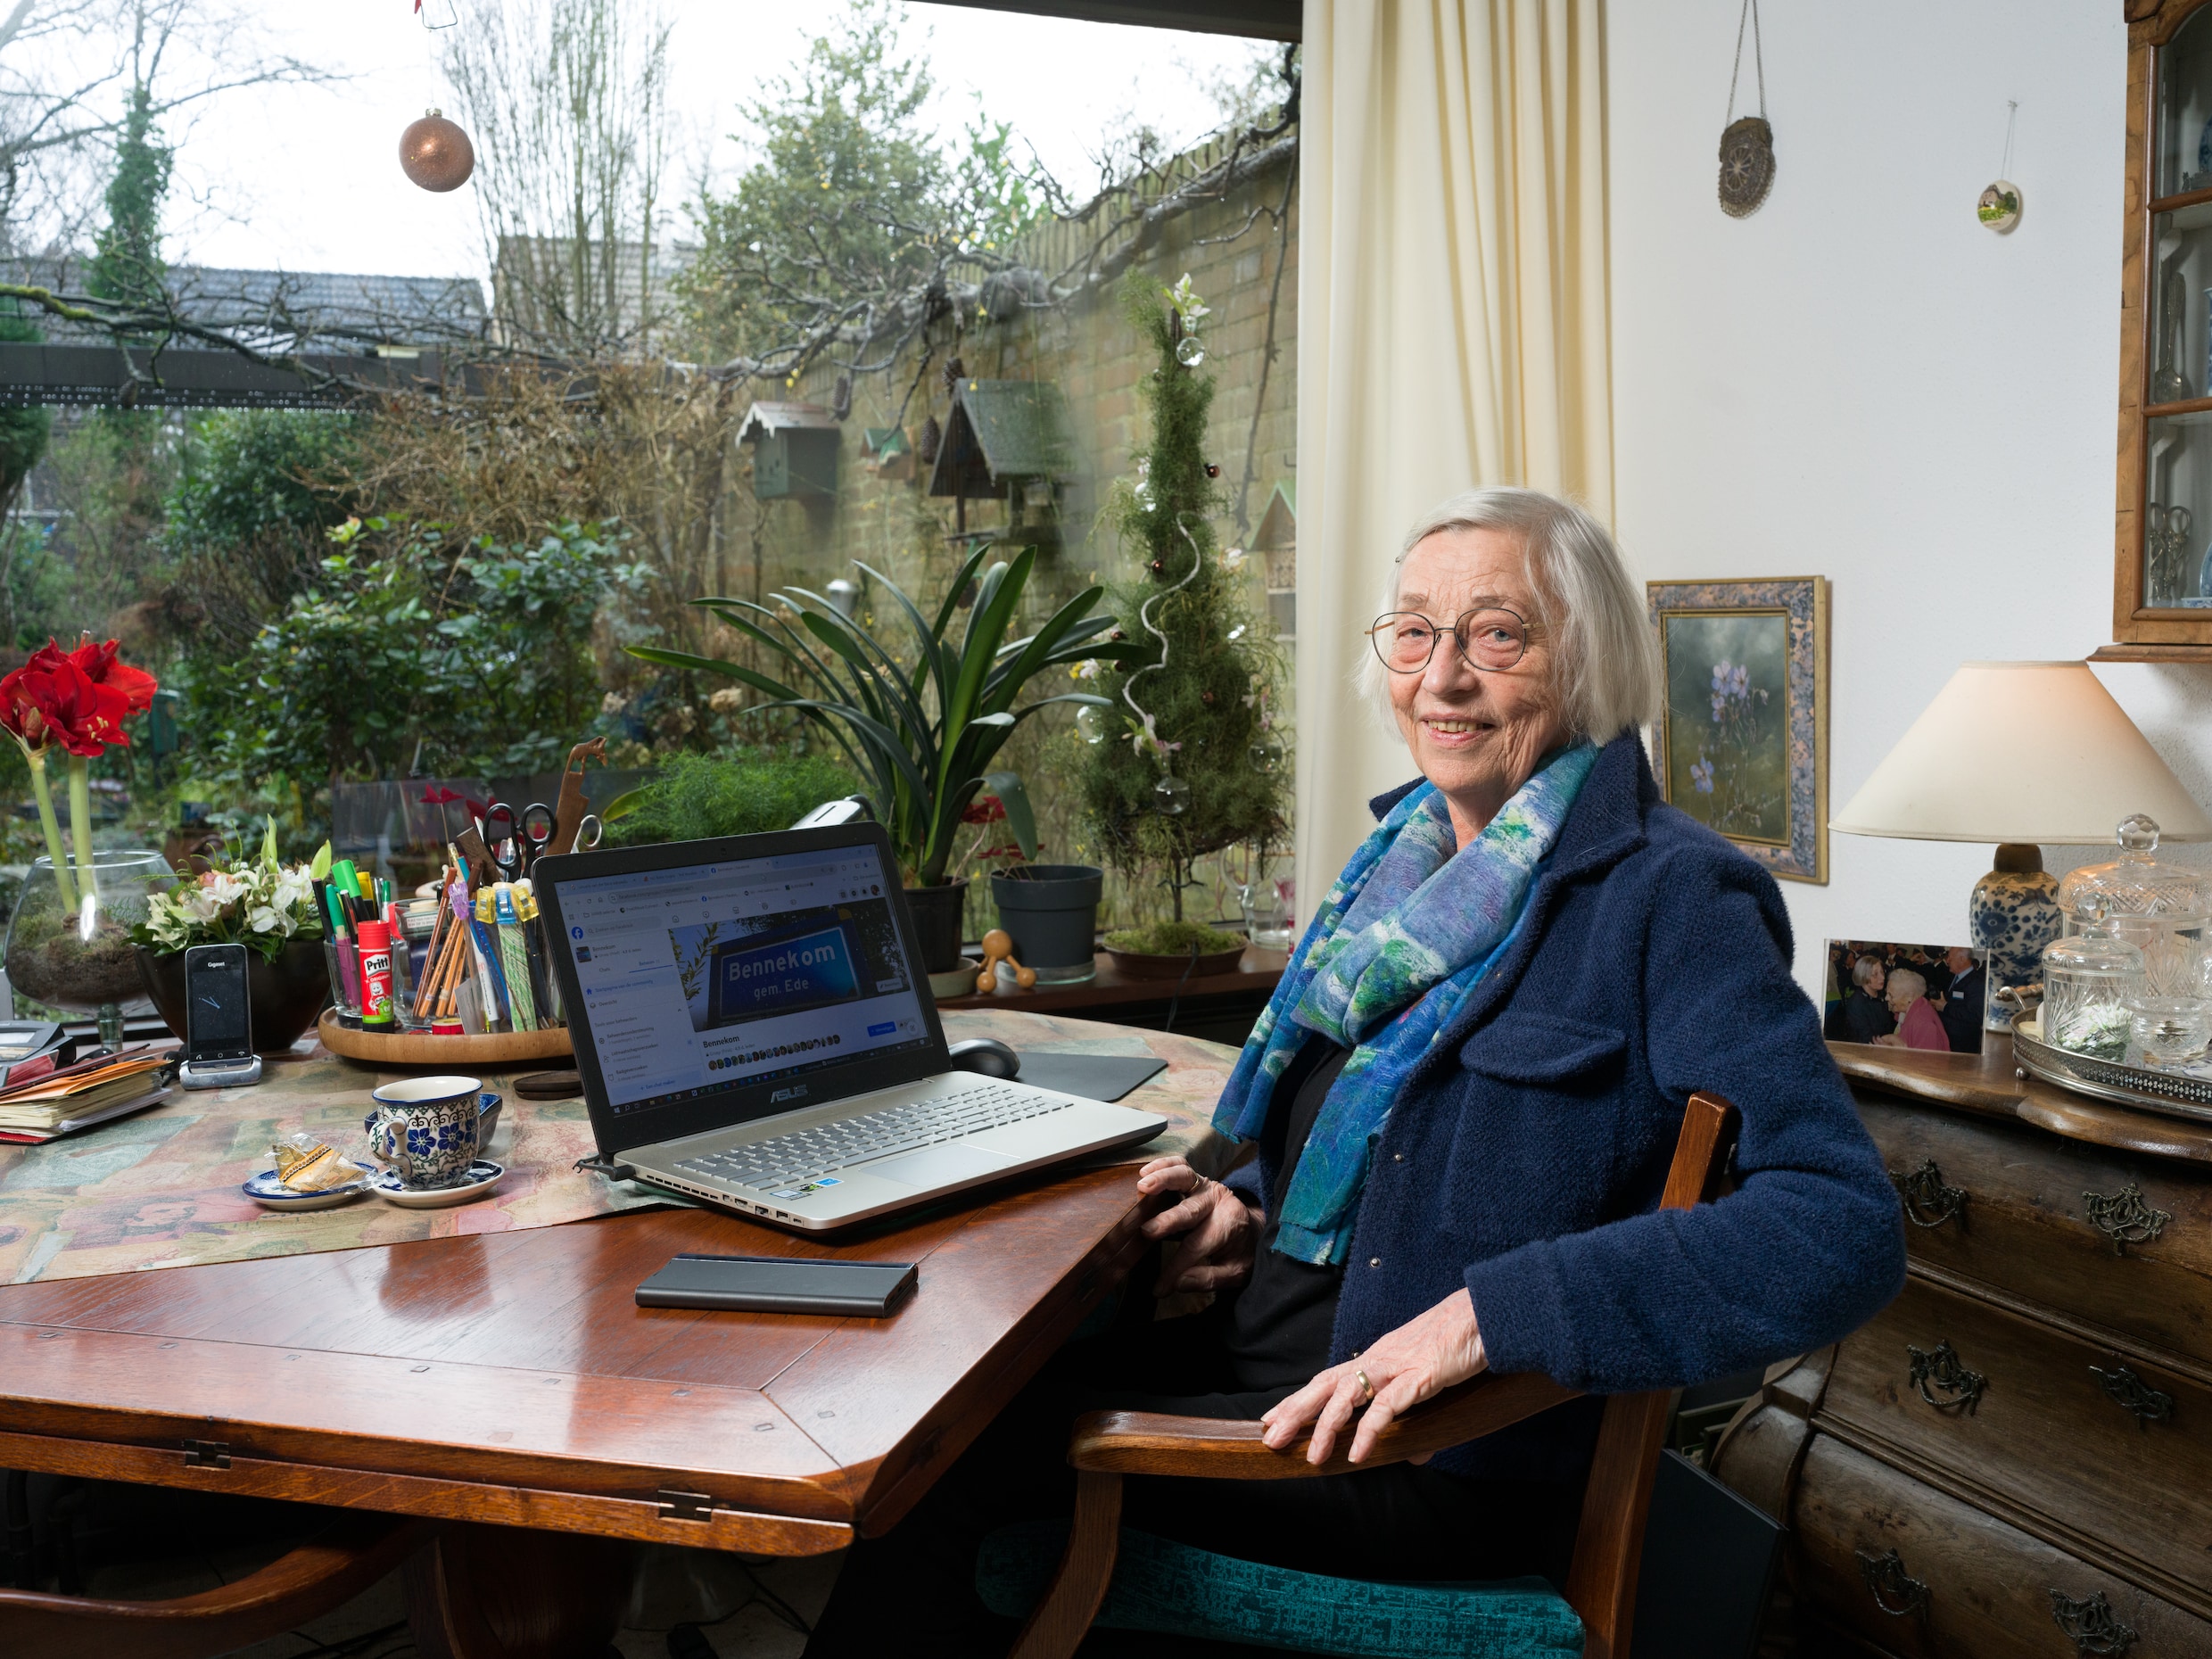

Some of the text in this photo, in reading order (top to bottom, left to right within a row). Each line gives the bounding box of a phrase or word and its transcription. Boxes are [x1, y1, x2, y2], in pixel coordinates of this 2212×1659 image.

[367, 957, 389, 970] Pritt
[729, 944, 836, 981] Bennekom
[754, 978, 809, 1001] gem. Ede
[703, 1036, 740, 1049] Bennekom
[770, 1085, 809, 1103] ASUS
